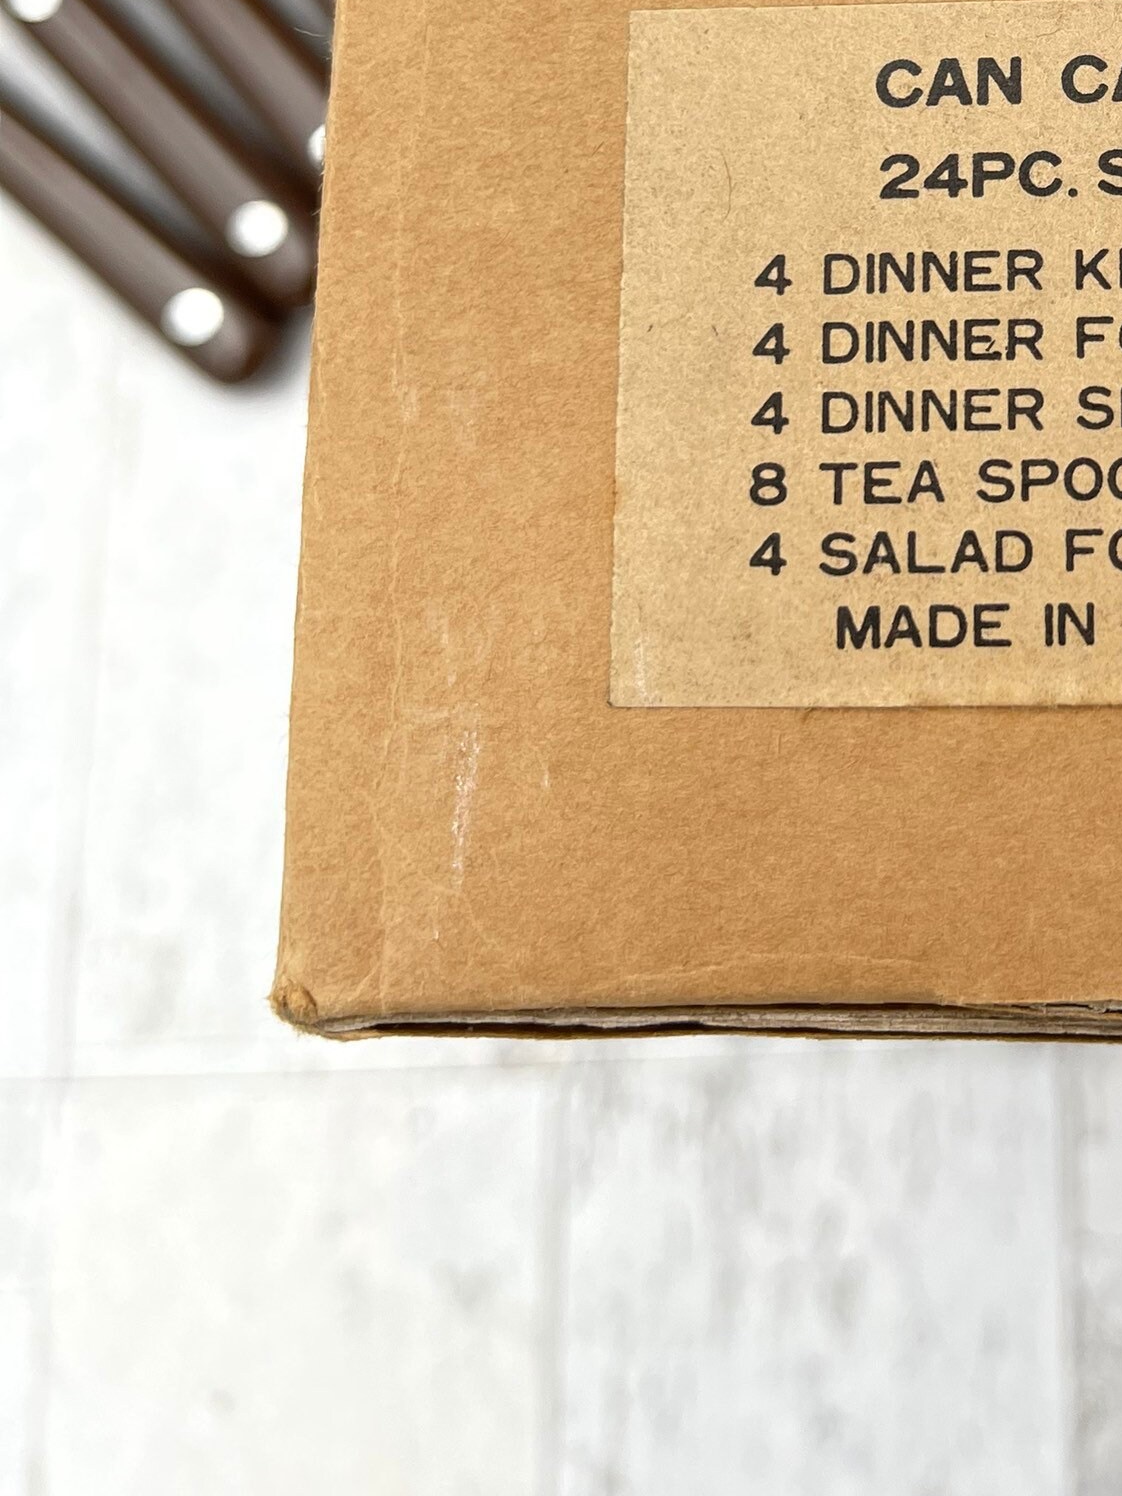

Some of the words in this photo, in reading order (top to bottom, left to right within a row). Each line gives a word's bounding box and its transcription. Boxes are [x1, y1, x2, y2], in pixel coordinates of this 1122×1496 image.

[876, 56, 1022, 108] CAN
[879, 150, 1078, 200] 24PC.
[754, 254, 793, 296] 4
[823, 249, 1044, 295] DINNER
[752, 322, 791, 365] 4
[821, 318, 1044, 365] DINNER
[750, 391, 789, 435] 4
[821, 388, 1044, 434] DINNER
[749, 462, 787, 507] 8
[819, 460, 945, 506] TEA
[749, 532, 787, 576] 4
[819, 530, 1033, 577] SALAD
[836, 603, 1012, 650] MADE
[1044, 602, 1095, 647] IN
